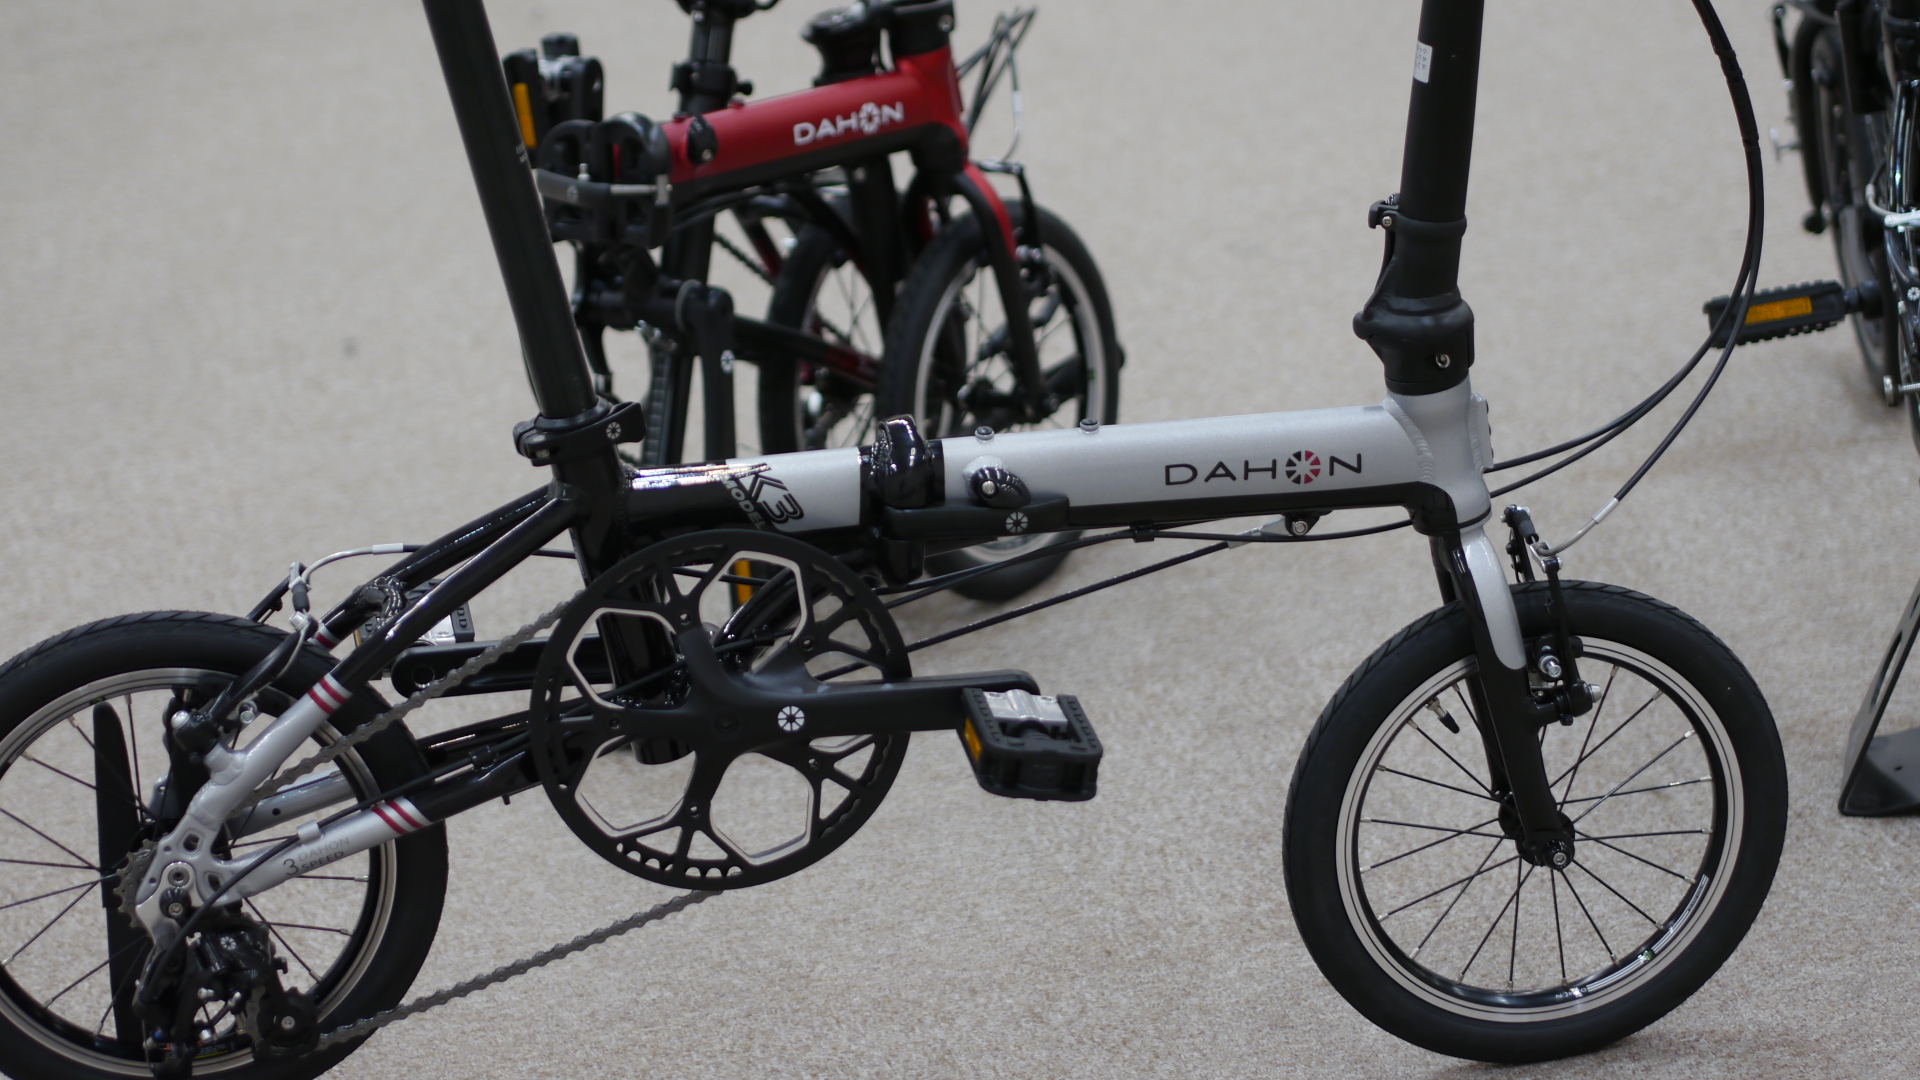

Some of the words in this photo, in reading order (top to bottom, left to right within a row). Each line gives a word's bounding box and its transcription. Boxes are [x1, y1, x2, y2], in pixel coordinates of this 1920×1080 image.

[793, 101, 904, 146] DAHON
[1164, 449, 1362, 486] DAHON
[283, 858, 299, 876] 3
[301, 851, 344, 871] SPEED
[299, 836, 350, 861] DAHON
